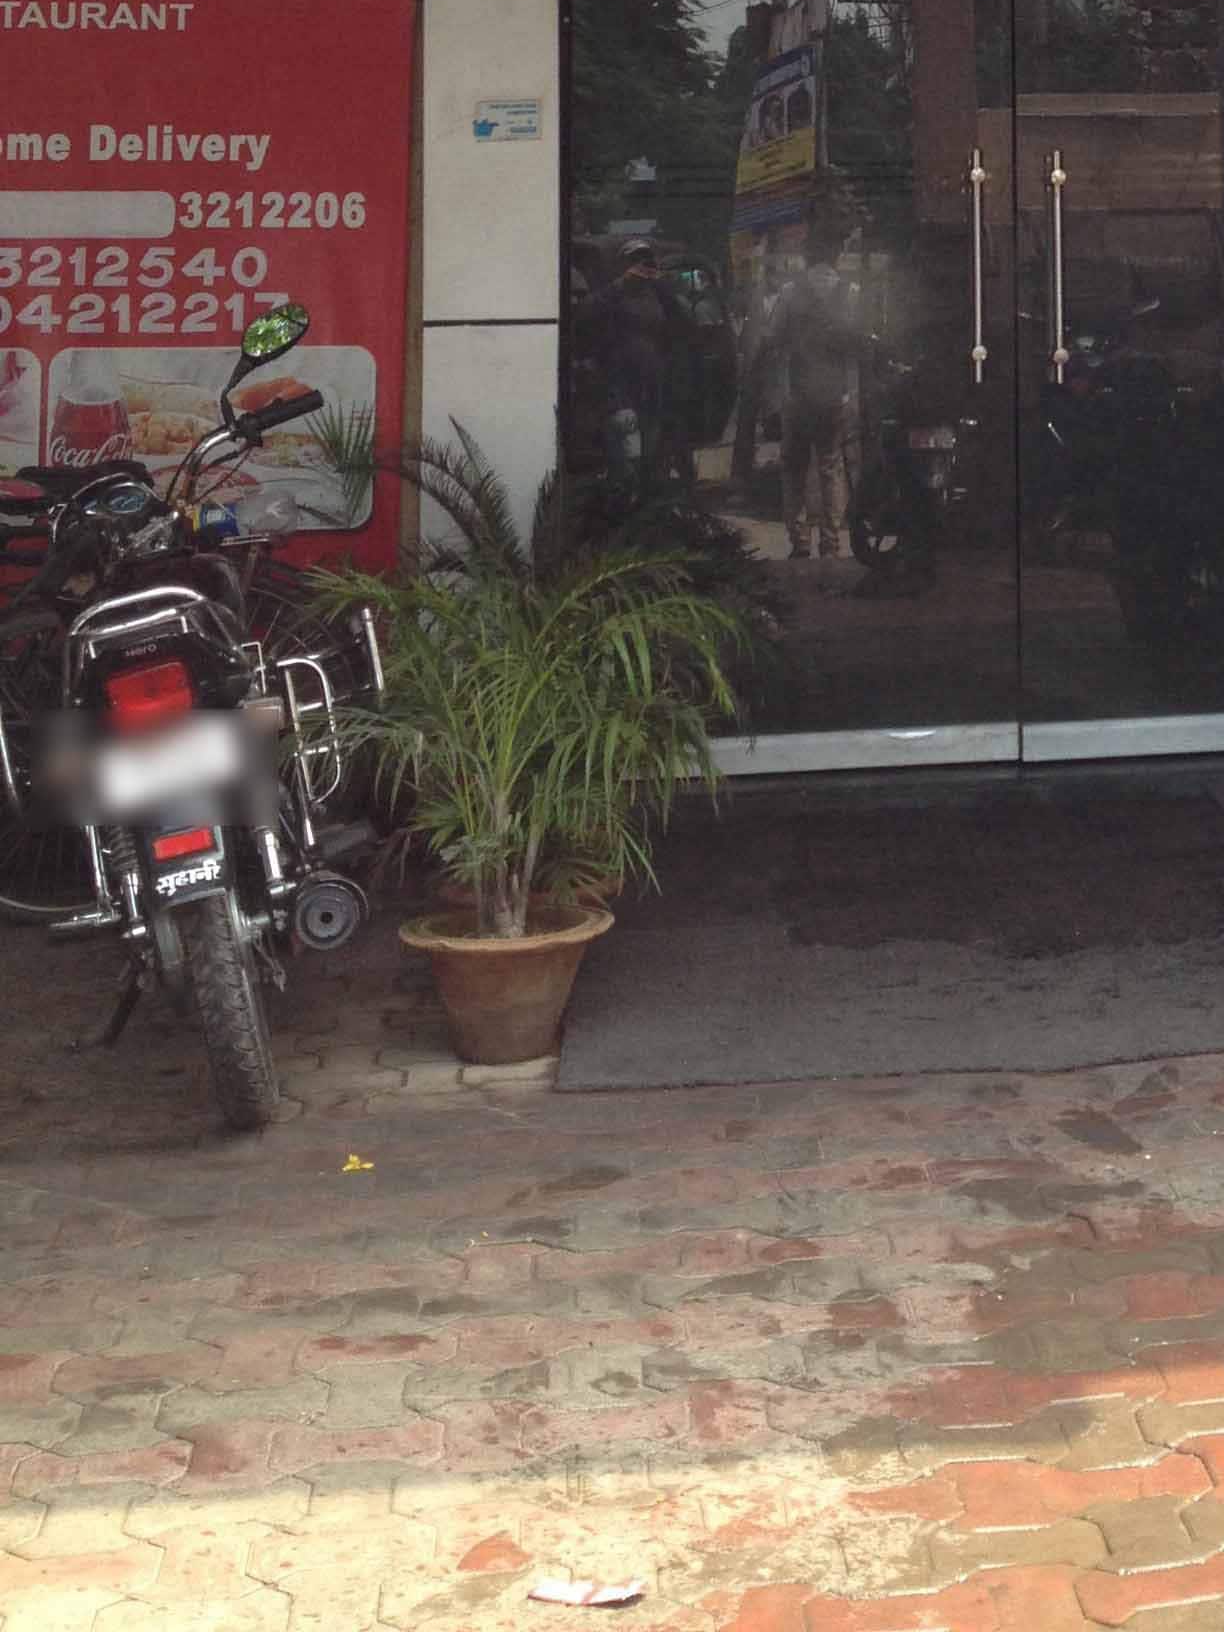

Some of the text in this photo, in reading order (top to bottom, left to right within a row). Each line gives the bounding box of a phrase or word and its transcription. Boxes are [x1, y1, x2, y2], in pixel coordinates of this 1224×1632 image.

[0, 125, 270, 171] me Delivery
[178, 191, 367, 228] 3212206
[156, 858, 221, 896] सुहानी
